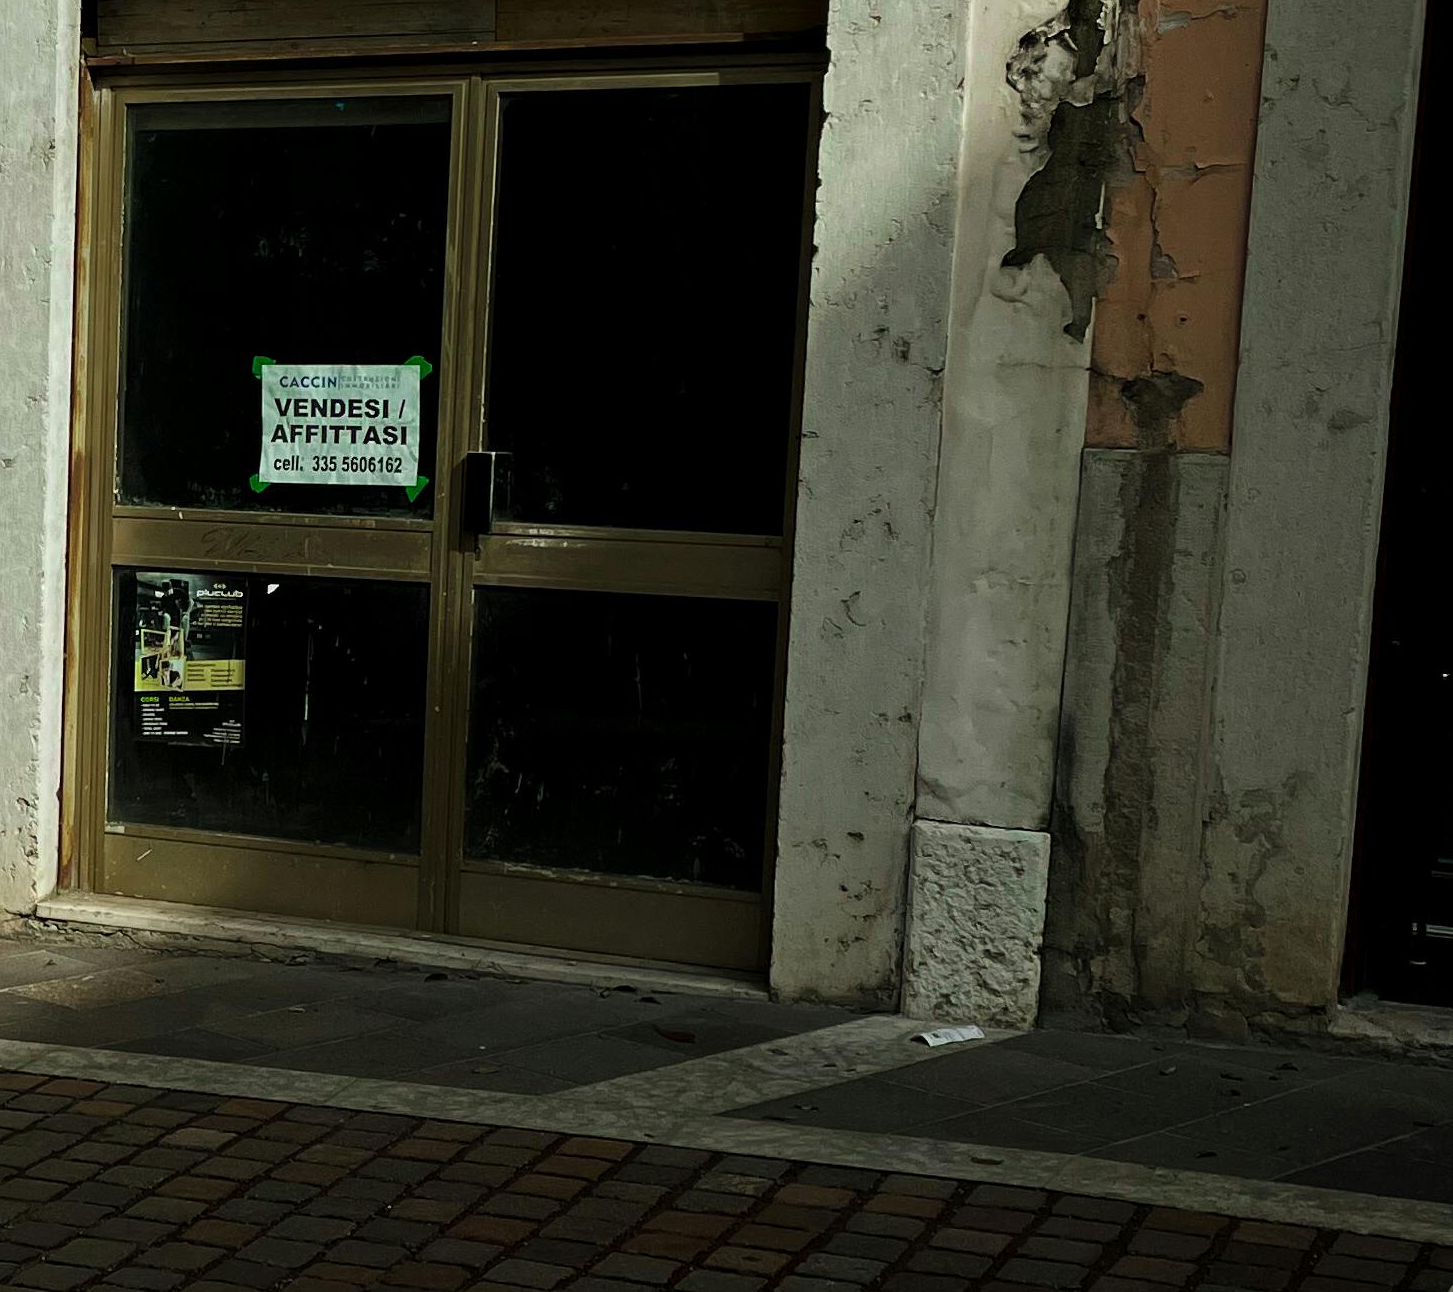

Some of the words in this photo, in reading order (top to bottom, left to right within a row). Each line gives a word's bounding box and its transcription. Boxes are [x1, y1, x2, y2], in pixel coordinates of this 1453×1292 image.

[279, 375, 337, 388] CACCIN
[274, 398, 389, 419] VENDESI
[270, 424, 408, 445] AFFITTASI
[273, 455, 304, 472] cell.
[312, 456, 337, 472] 335
[342, 456, 402, 473] 5606162
